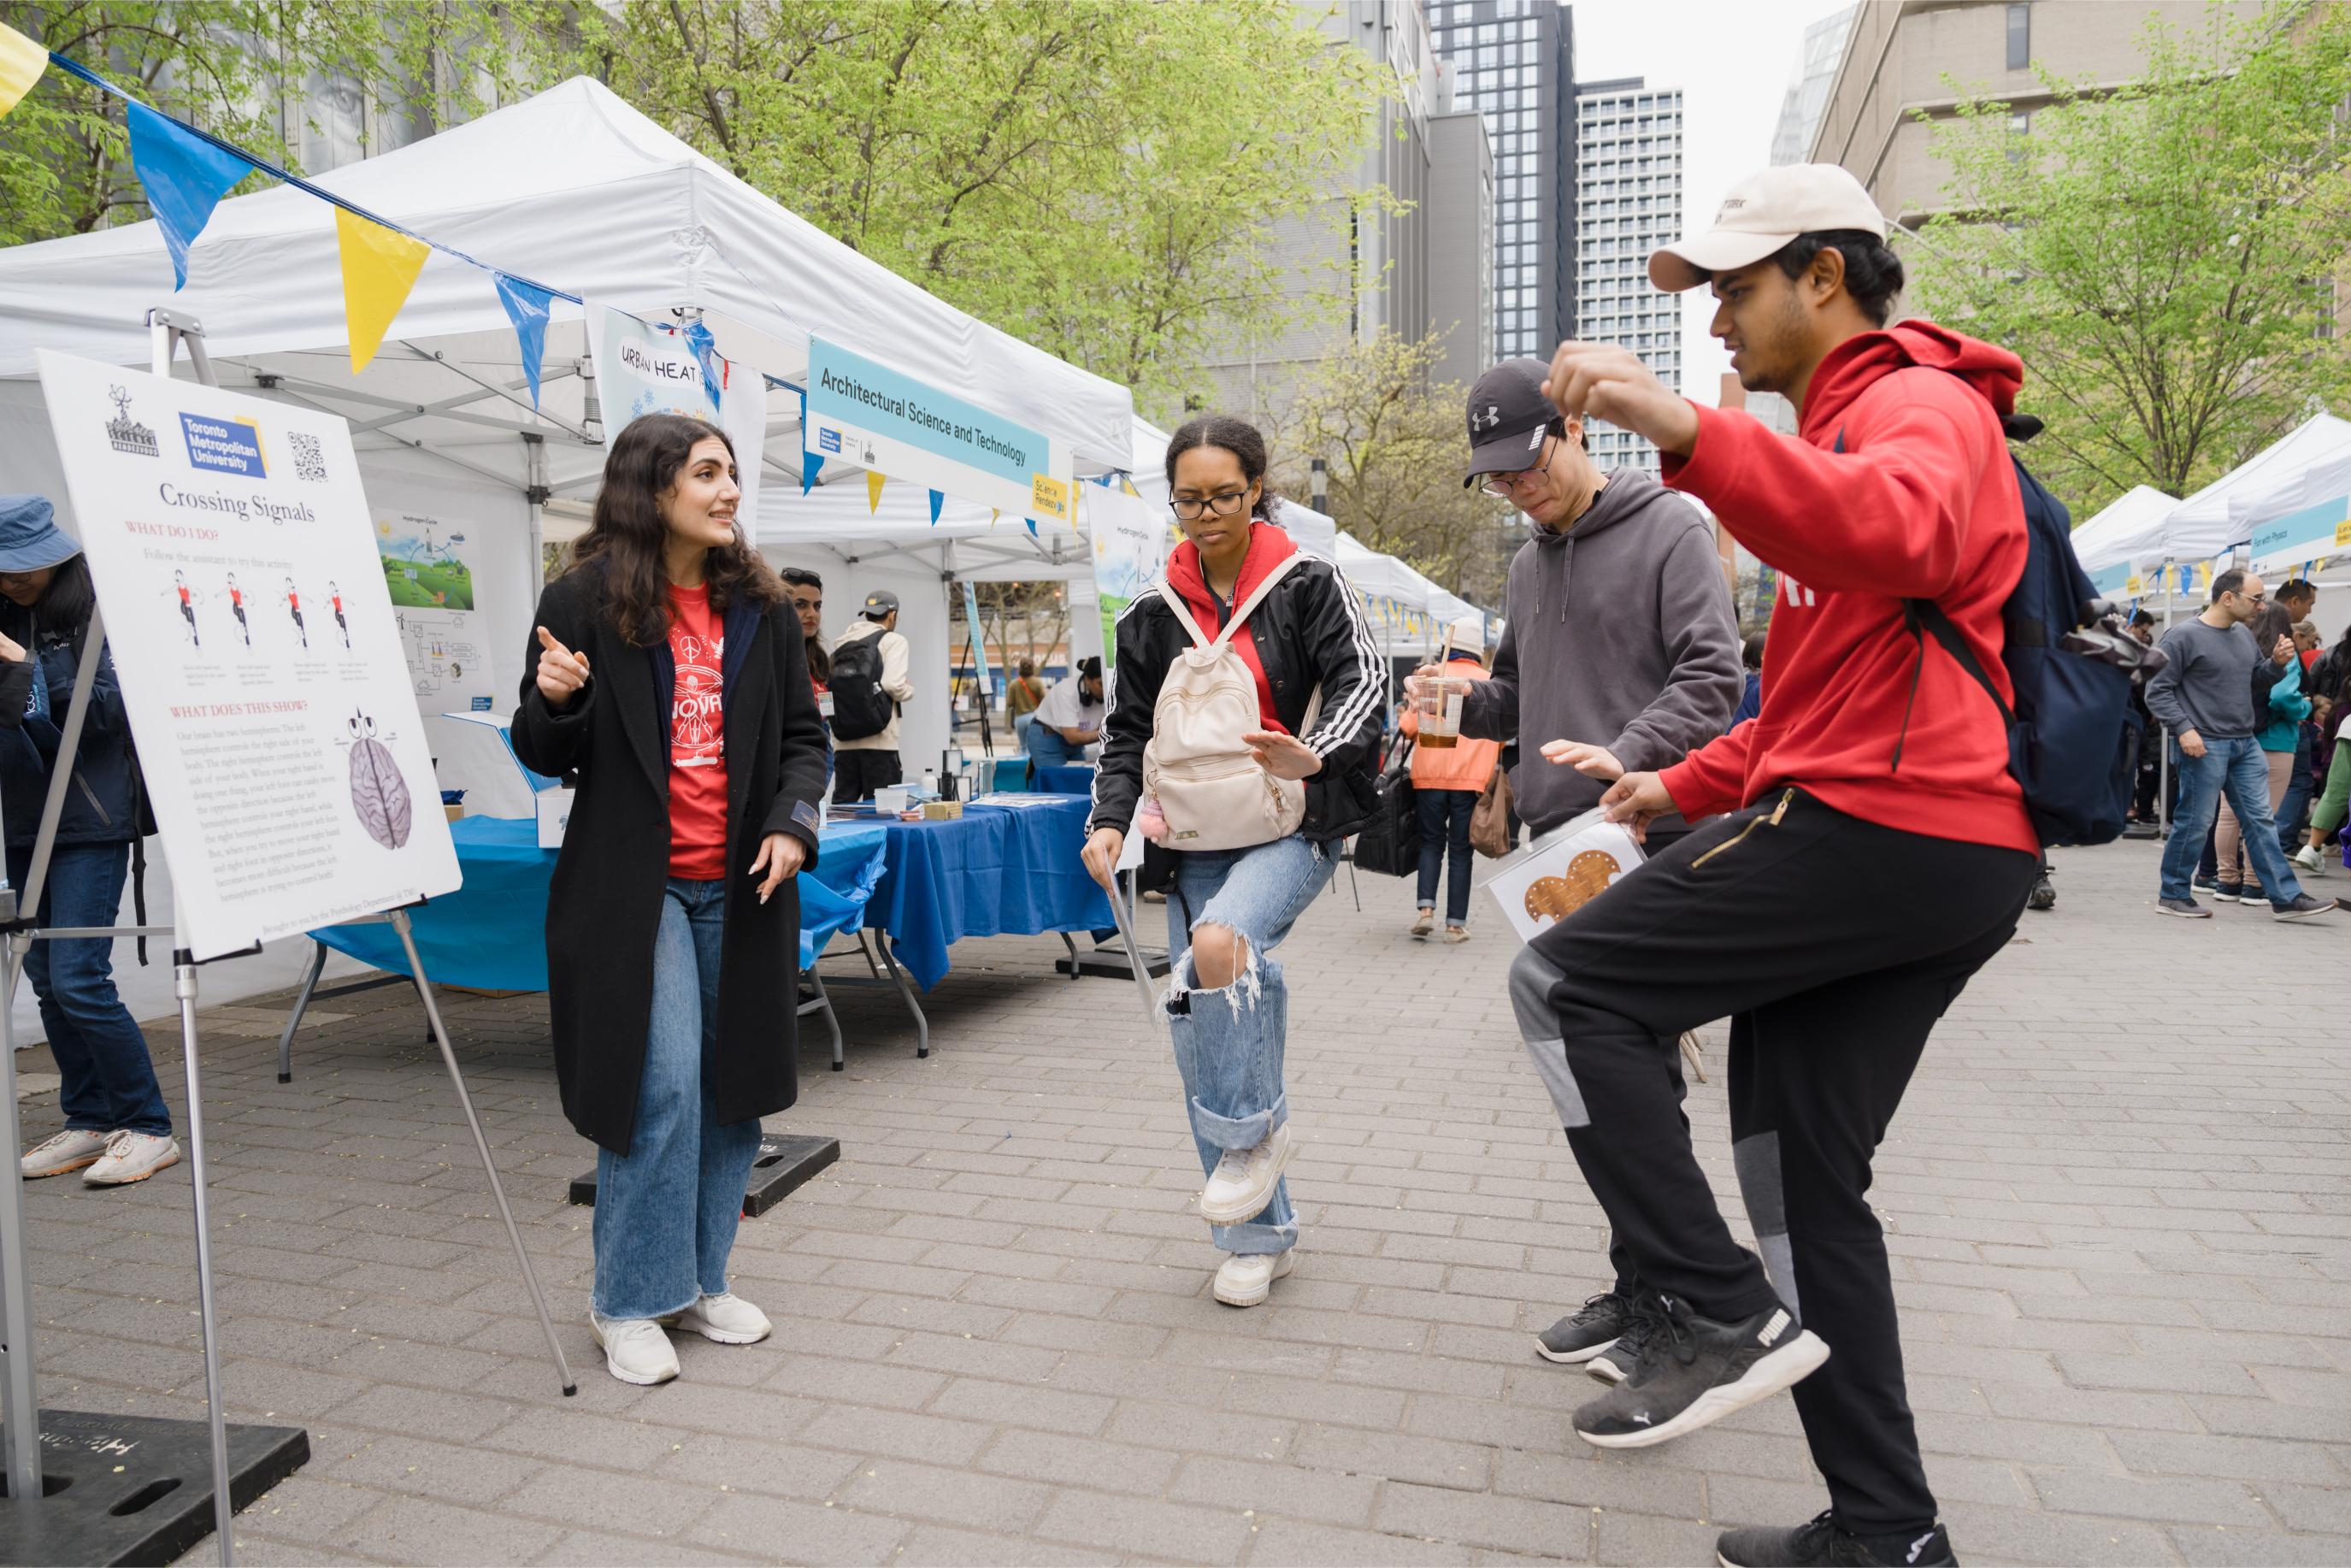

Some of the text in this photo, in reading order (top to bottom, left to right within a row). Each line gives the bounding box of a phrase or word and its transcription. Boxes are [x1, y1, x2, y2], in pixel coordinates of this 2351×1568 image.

[622, 345, 651, 373] URBAN
[654, 360, 695, 383] HEAT
[184, 418, 228, 439] Toronto
[821, 368, 1026, 468] Architectural Science and Technology
[109, 429, 157, 447] SCIENCE
[189, 433, 257, 458] Metropolitan
[191, 450, 248, 472] University
[160, 482, 315, 526] Crossing Signals
[125, 521, 219, 540] WHAT DO I DO?
[403, 516, 425, 525] Hydrogen
[2254, 530, 2288, 548] Fun with Physics
[170, 700, 308, 718] WHAT DOES THIS SHOW?
[1757, 1308, 1792, 1347] PUMA
